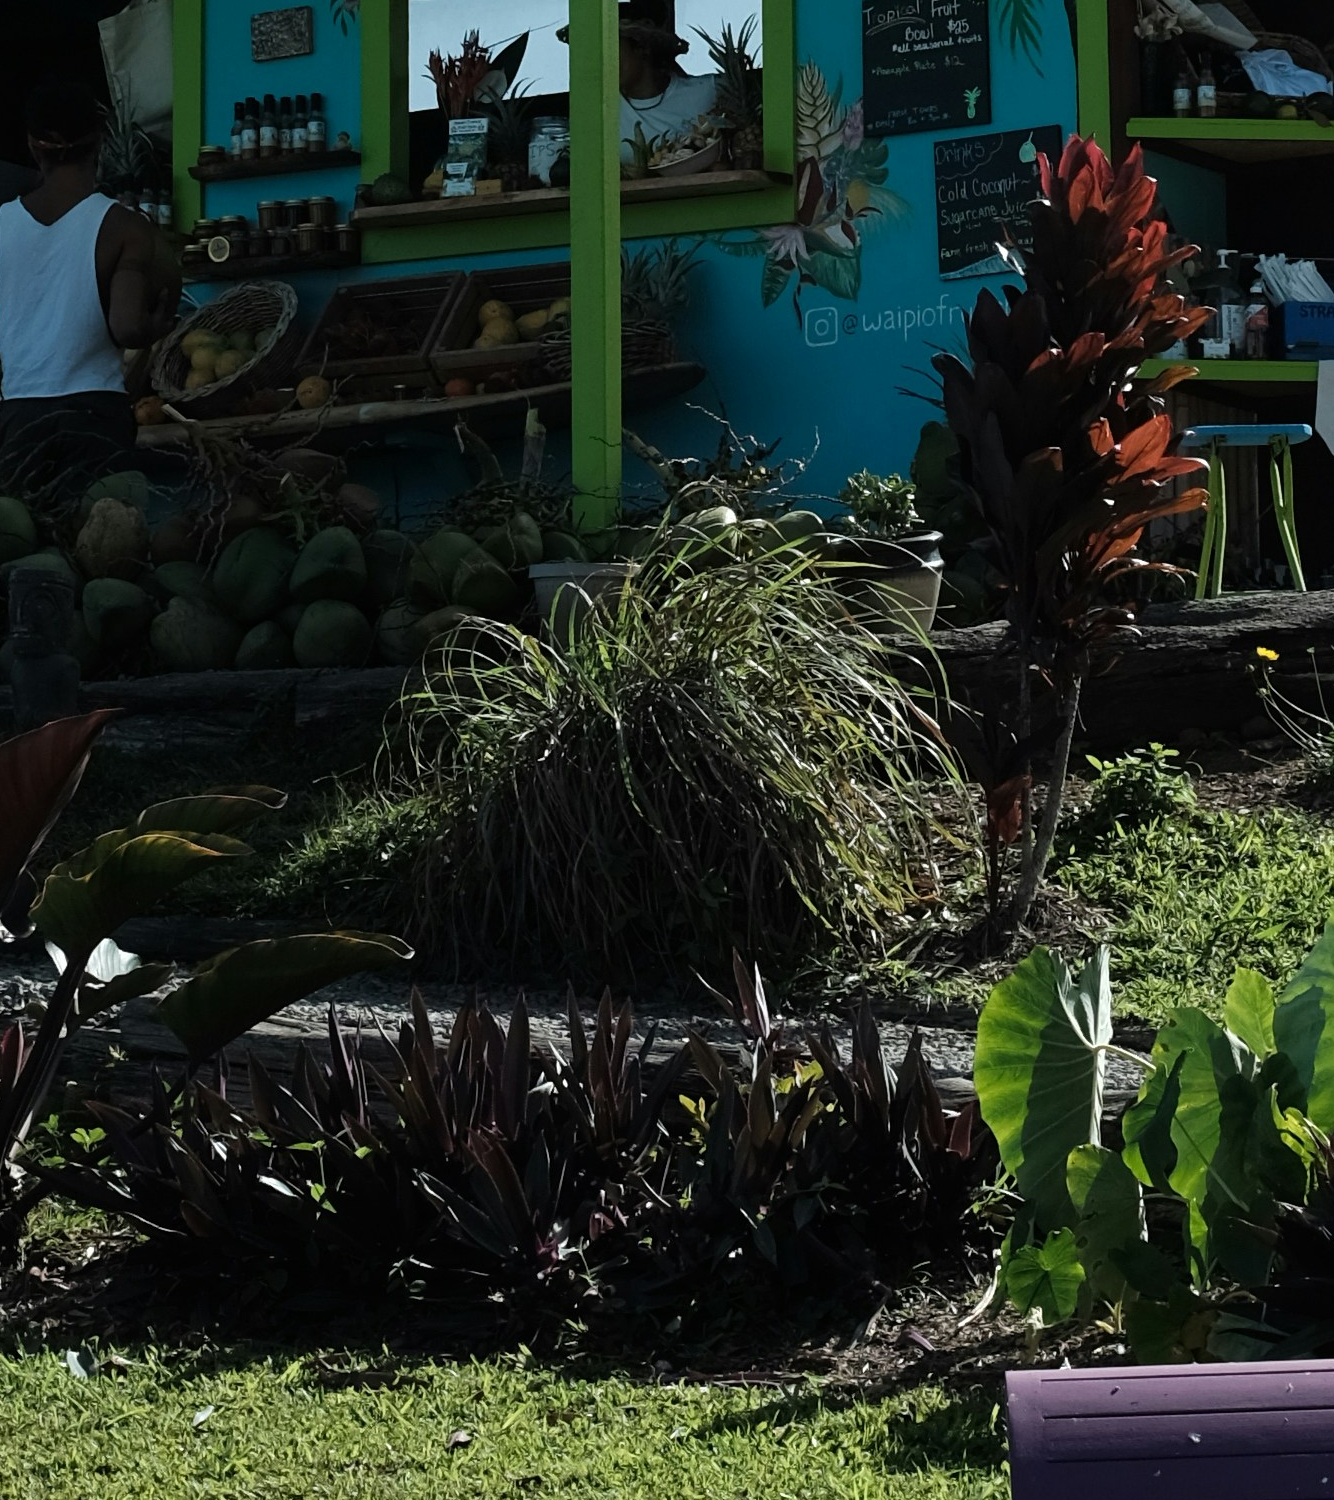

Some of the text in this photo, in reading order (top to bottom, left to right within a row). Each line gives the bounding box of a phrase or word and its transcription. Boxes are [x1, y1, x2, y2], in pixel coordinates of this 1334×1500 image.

[905, 18, 969, 42] Bowl $25
[935, 141, 985, 168] Drinks
[938, 171, 1021, 204] Cold Coconut
[1001, 199, 1028, 216] Juic
